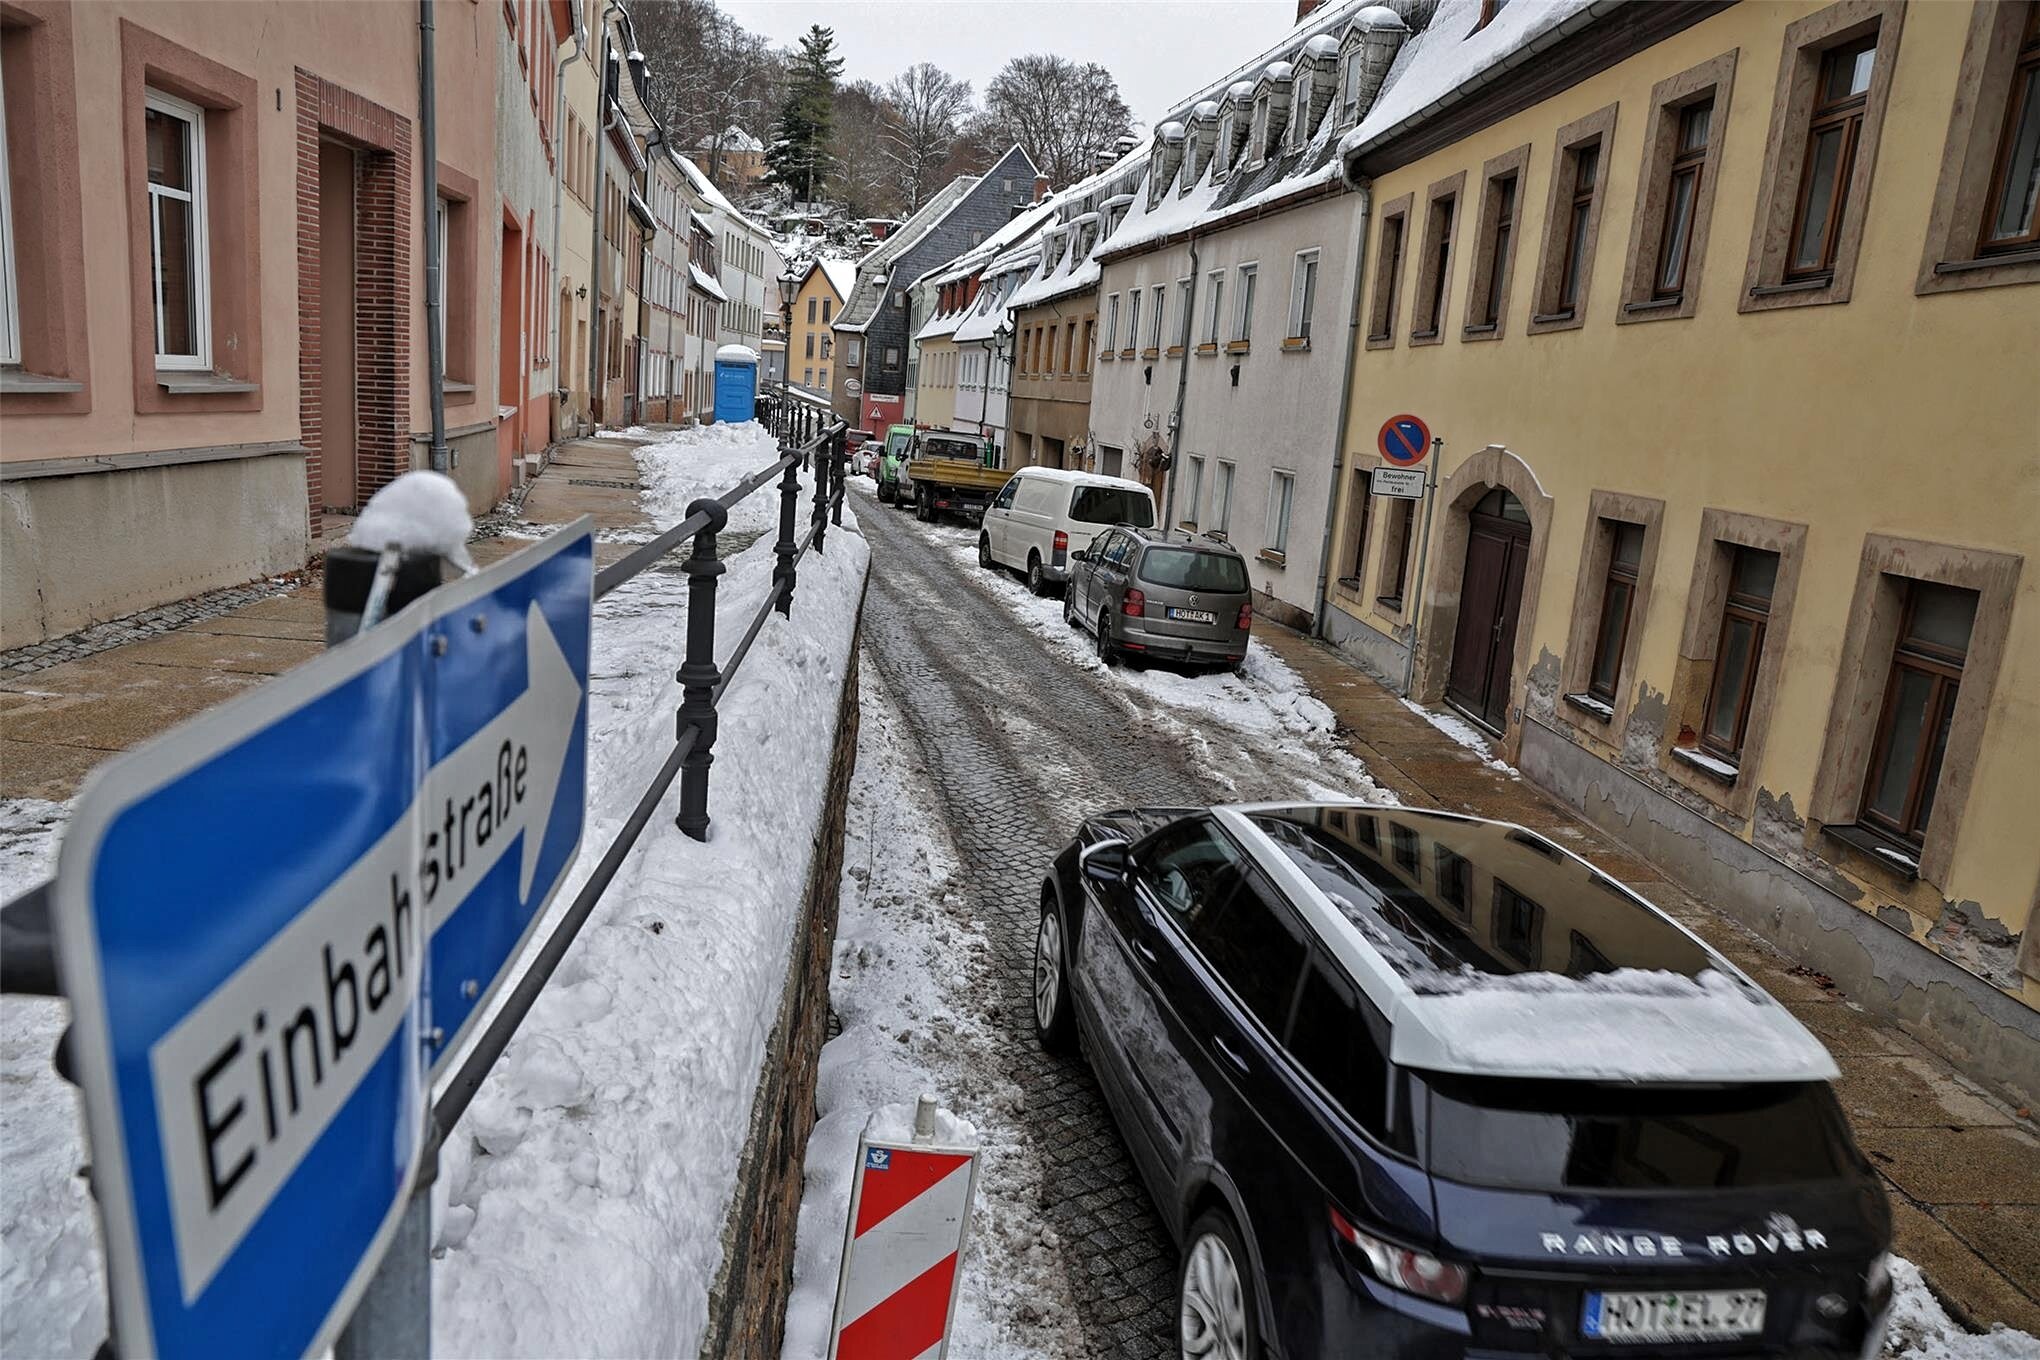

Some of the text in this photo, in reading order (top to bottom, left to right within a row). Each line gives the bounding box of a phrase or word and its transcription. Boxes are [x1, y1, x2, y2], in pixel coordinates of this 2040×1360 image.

[1382, 471, 1417, 480] Bewohner
[1391, 485, 1405, 493] frei
[195, 738, 528, 1212] Einbahstraße
[1541, 1229, 1828, 1257] RANGE ROVER
